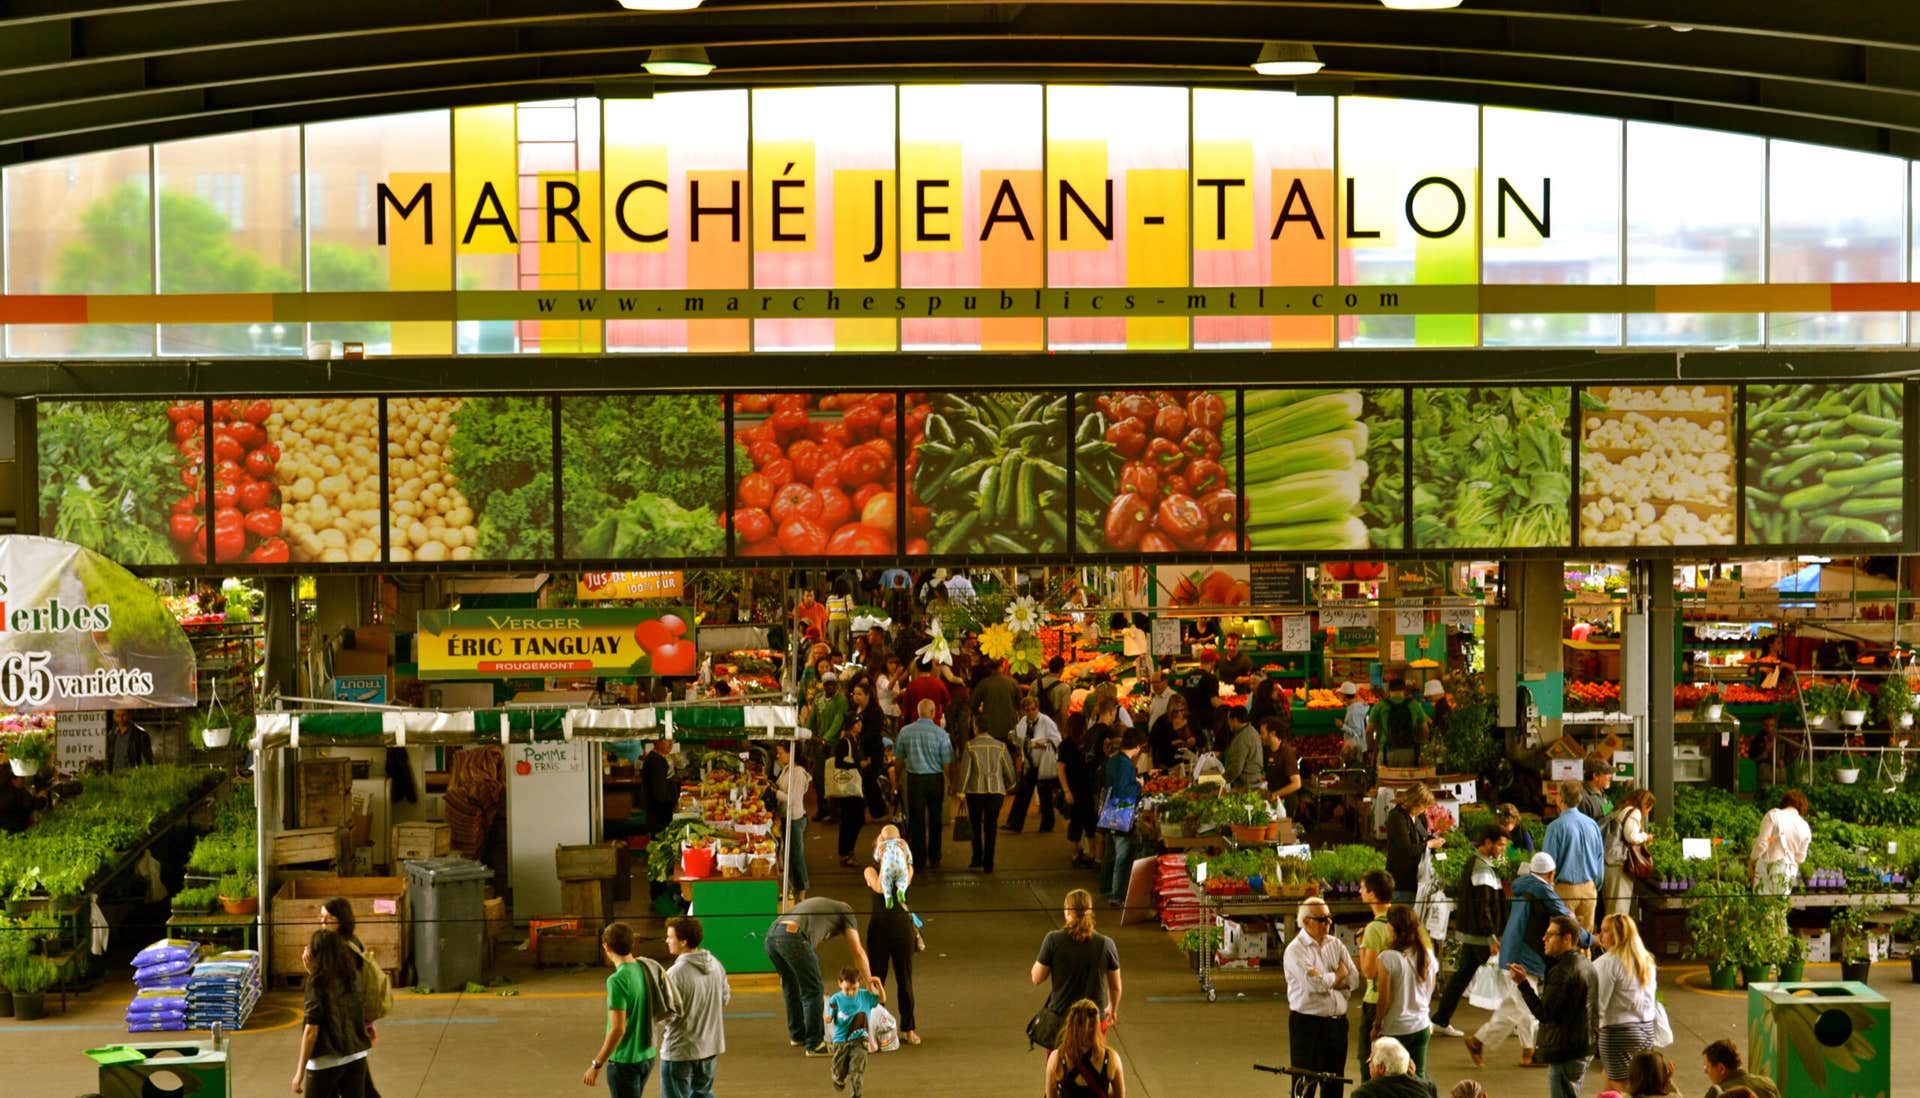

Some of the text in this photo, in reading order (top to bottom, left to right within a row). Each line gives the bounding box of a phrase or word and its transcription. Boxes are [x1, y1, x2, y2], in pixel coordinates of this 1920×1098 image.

[376, 162, 1551, 262] MARCHÉ JEAN-TALON
[537, 289, 1400, 318] www.marchespublics-mtl.com
[588, 572, 608, 588] JUS
[627, 578, 676, 593] 100% PUR
[447, 634, 622, 657] ÉRIC TANGUAY
[1, 654, 154, 701] 65 variétés
[495, 662, 575, 671] ROUGEMONT
